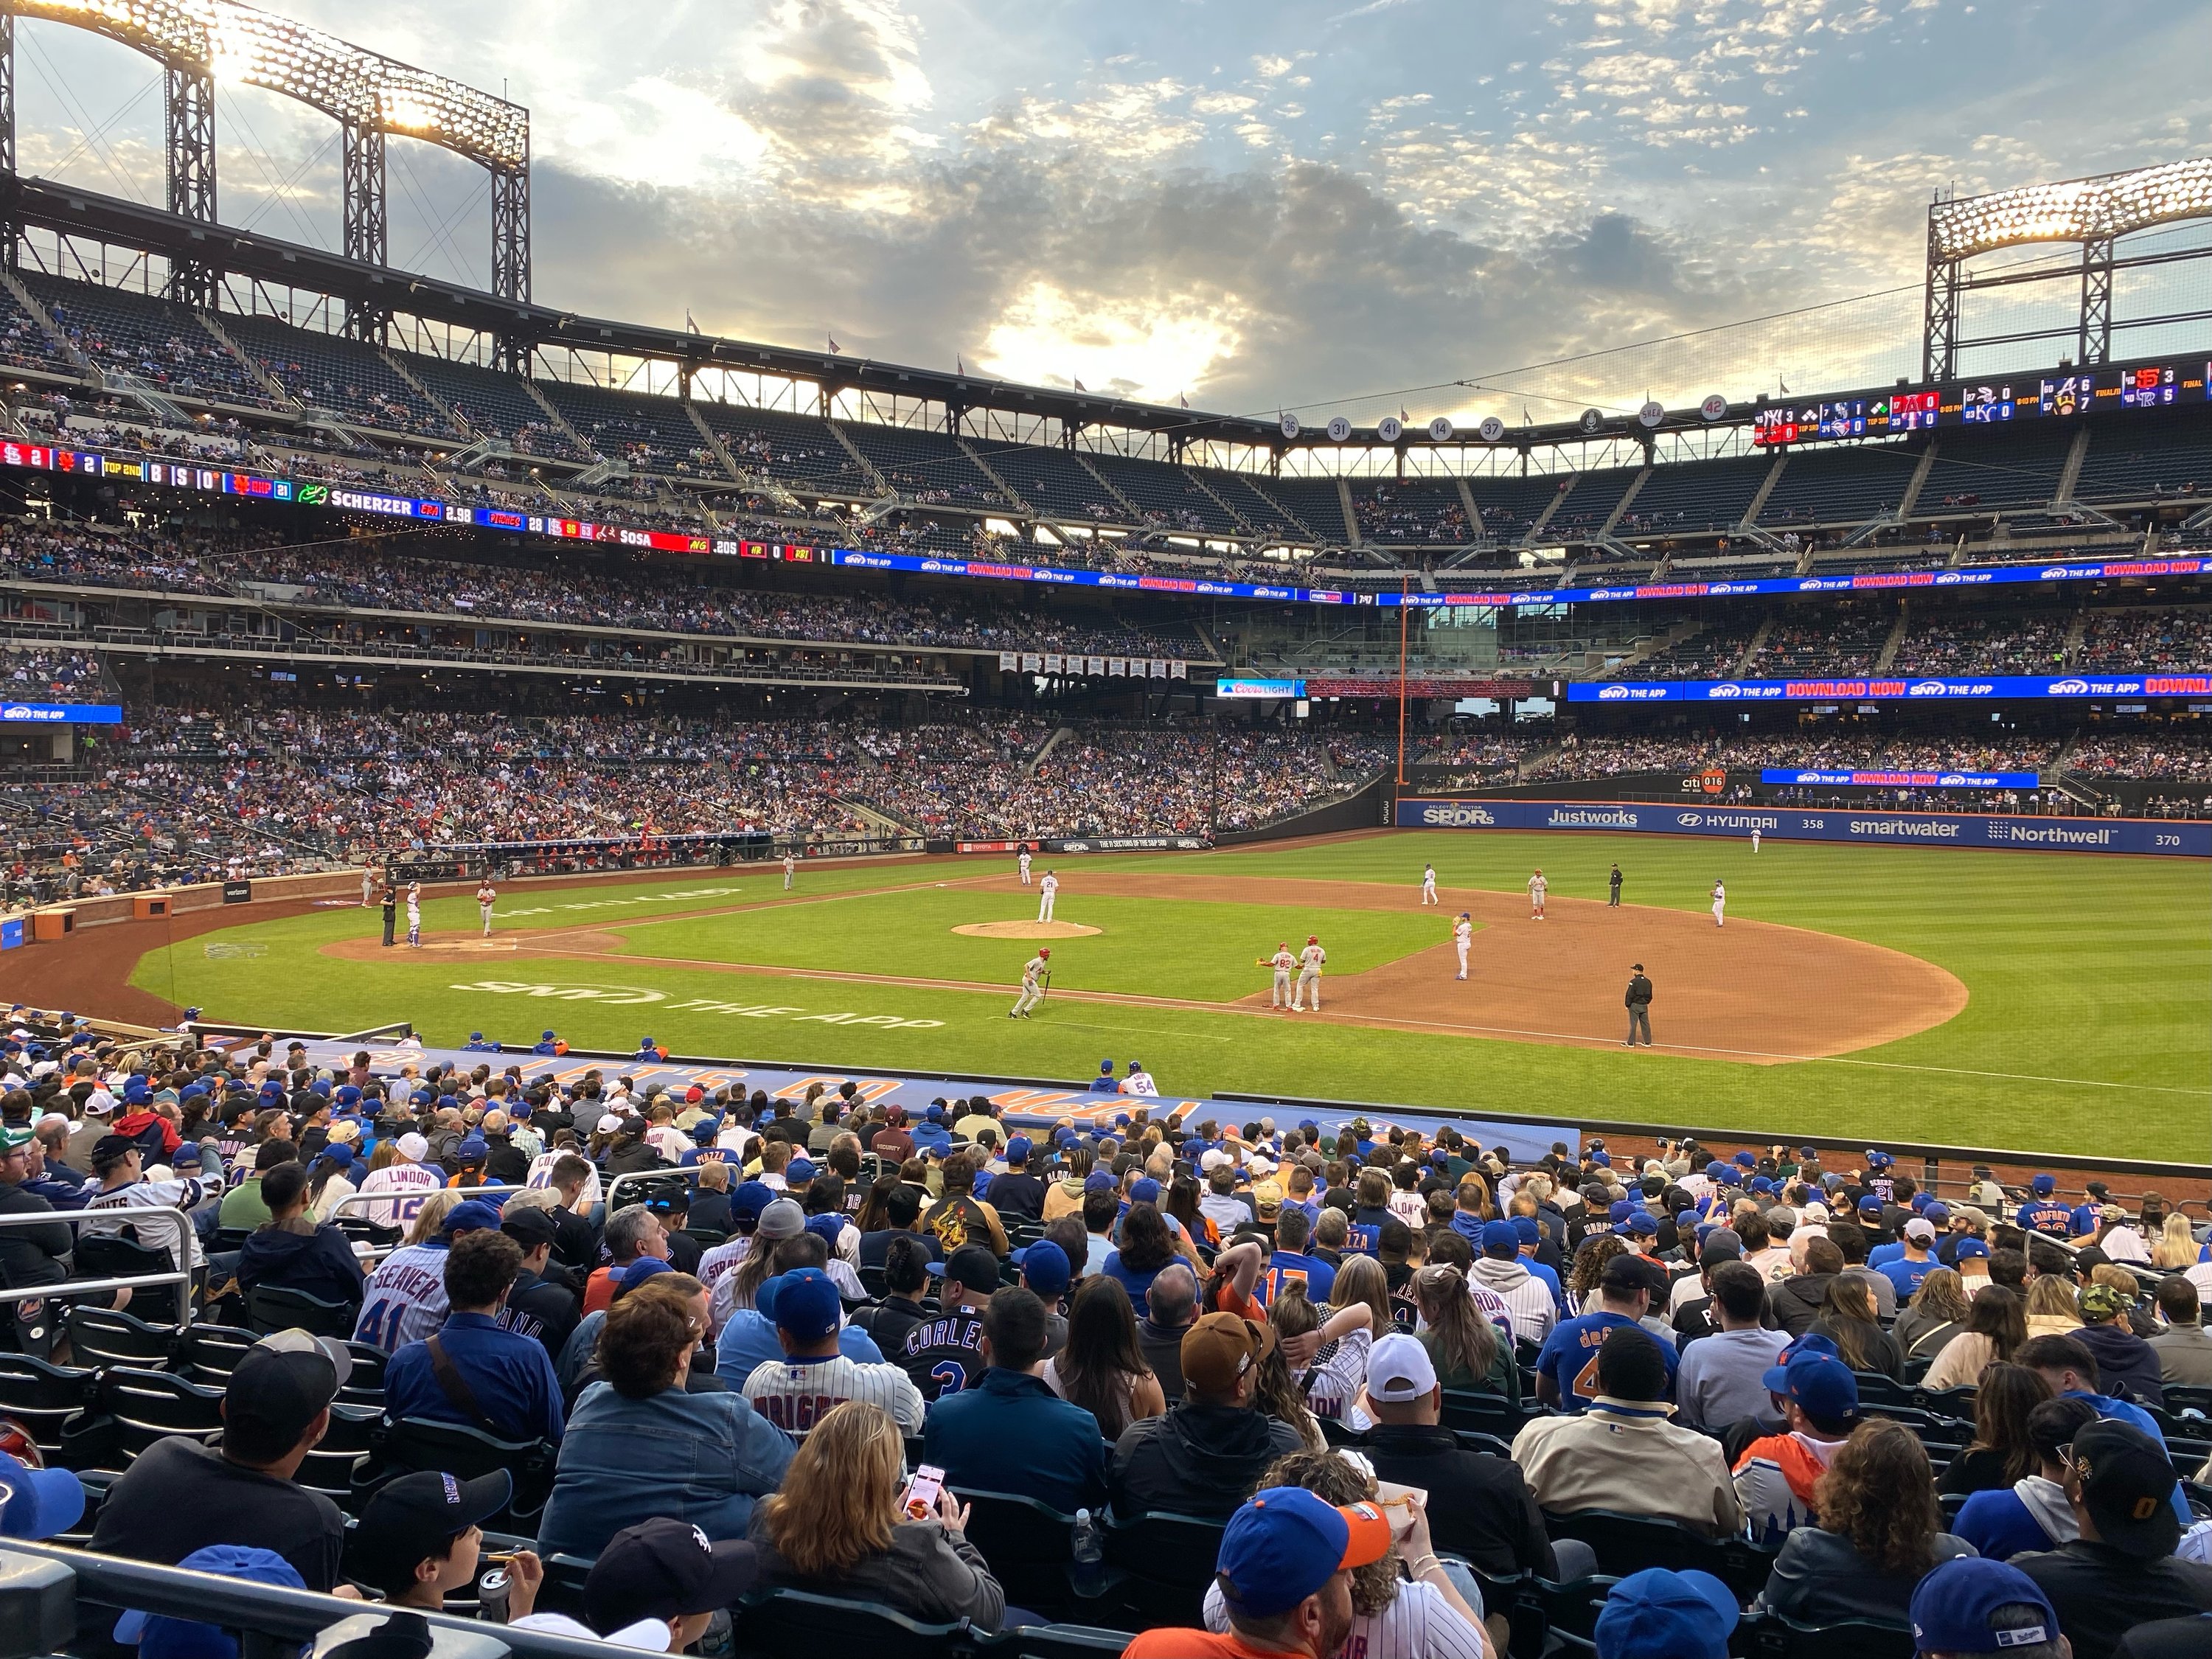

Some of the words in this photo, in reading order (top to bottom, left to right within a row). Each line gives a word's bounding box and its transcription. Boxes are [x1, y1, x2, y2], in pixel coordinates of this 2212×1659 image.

[2165, 370, 2174, 383] 3
[2081, 379, 2090, 392] 6
[2183, 380, 2202, 389] FINAL
[2002, 387, 2010, 400] 0
[2164, 389, 2173, 402] 5
[1705, 401, 1722, 413] 42
[1927, 396, 1933, 407] 0
[2081, 397, 2089, 410] 7
[1642, 409, 1663, 419] SHEA
[1856, 403, 1861, 414] 1
[2002, 406, 2009, 417] 0
[1786, 411, 1793, 422] 3
[1927, 414, 1933, 425] 0
[1284, 420, 1295, 433] 36
[1333, 424, 1346, 435] 31
[1384, 422, 1397, 435] 41
[1435, 423, 1447, 434] 14
[1485, 422, 1499, 435] 37
[1854, 420, 1861, 431] 0
[1786, 428, 1792, 438] 0
[31, 450, 41, 466] 2
[84, 456, 94, 473] 2
[104, 462, 121, 474] TOP
[122, 465, 142, 476] 2ND
[151, 465, 161, 482] B
[177, 468, 187, 486] S
[251, 481, 271, 495] RHP
[277, 484, 288, 496] 21
[332, 491, 411, 515] SCHERZER
[421, 504, 439, 516] ERA
[445, 506, 471, 523] 2.98
[490, 513, 521, 527] PITCHES
[529, 517, 543, 532] 28
[581, 524, 591, 536] 63
[620, 529, 651, 547] SOSA
[689, 540, 707, 551] AVG
[713, 540, 737, 554] .205
[751, 546, 762, 555] HR
[773, 546, 780, 558] 0
[795, 549, 809, 560] RBI
[821, 550, 826, 562] 1
[844, 554, 866, 565] SNY
[867, 558, 878, 566] THE
[878, 559, 891, 567] APP
[921, 560, 941, 571] SNY
[942, 564, 953, 572] THE
[953, 565, 965, 573] APP
[967, 565, 1012, 577] DOWNLOAD
[1013, 568, 1032, 578] NOW
[2104, 563, 2168, 575] DOWNLOAD
[2171, 561, 2199, 572] NOW
[2041, 568, 2067, 579] SNY
[2069, 569, 2084, 577] THE
[2085, 568, 2101, 577] APP
[1139, 578, 1178, 590] DOWNLOAD
[1180, 581, 1196, 591] NOW
[1800, 580, 1822, 590] SNY
[1836, 580, 1849, 588] APP
[1853, 575, 1907, 588] DOWNLOAD
[1909, 574, 1934, 585] NOW
[1311, 593, 1340, 602] mets.com
[1636, 586, 1684, 597] DOWNLOAD
[1686, 585, 1708, 594] NOW
[1359, 594, 1372, 604] 7:47
[1445, 596, 1490, 604] DOWNLOAD
[1491, 595, 1511, 604] NOW
[1235, 683, 1263, 694] Coors
[1265, 686, 1290, 695] LIGHT
[1295, 681, 1307, 697] K
[1599, 686, 1629, 698] SNY
[1630, 689, 1648, 698] THE
[1649, 689, 1666, 698] APP
[1709, 684, 1740, 697] SNY
[1743, 688, 1761, 696] THE
[1762, 687, 1781, 696] APP
[1786, 682, 1865, 696] DOWNLOAD
[1868, 681, 1906, 695] NOW
[1910, 681, 1946, 695] SNY
[1948, 685, 1969, 694] THE
[1970, 685, 1992, 694] APP
[2048, 680, 2088, 694] SNY
[2090, 684, 2113, 693] THE
[2115, 684, 2139, 693] APP
[2146, 678, 2212, 693] DOWNL
[4, 706, 32, 720] SNY
[32, 711, 48, 720] THE
[49, 712, 65, 720] APP
[1683, 778, 1700, 787] citi
[1705, 777, 1722, 785] 016
[1797, 773, 1820, 783] SNY
[1821, 775, 1834, 783] THE
[1853, 773, 1910, 785] DOWNLOAD
[1913, 773, 1938, 785] NOW
[1940, 775, 1966, 785] SNY
[1967, 778, 1981, 786] THE
[1983, 778, 1997, 786] APP
[1548, 809, 1638, 824] Justworks
[1707, 816, 1777, 829] HYUNDAI
[1802, 819, 1823, 830] 358
[1850, 821, 1959, 838] smartwater
[2011, 827, 2109, 845] Northwell
[2156, 835, 2180, 846] 370
[1149, 839, 1158, 847] S&P
[1280, 959, 1290, 968] 82
[1313, 953, 1318, 962] 4
[662, 999, 807, 1018] THE
[792, 1012, 947, 1029] APP
[1135, 1079, 1154, 1093] 54
[696, 1151, 726, 1164] PIAZZA
[389, 1170, 431, 1186] LINDOR
[1876, 1186, 1893, 1202] 21
[390, 1188, 426, 1220] 12
[2030, 1210, 2070, 1223] CONFORTO
[375, 1263, 440, 1303] SEAVER
[1266, 1267, 1308, 1307] 17
[356, 1298, 406, 1349] 41
